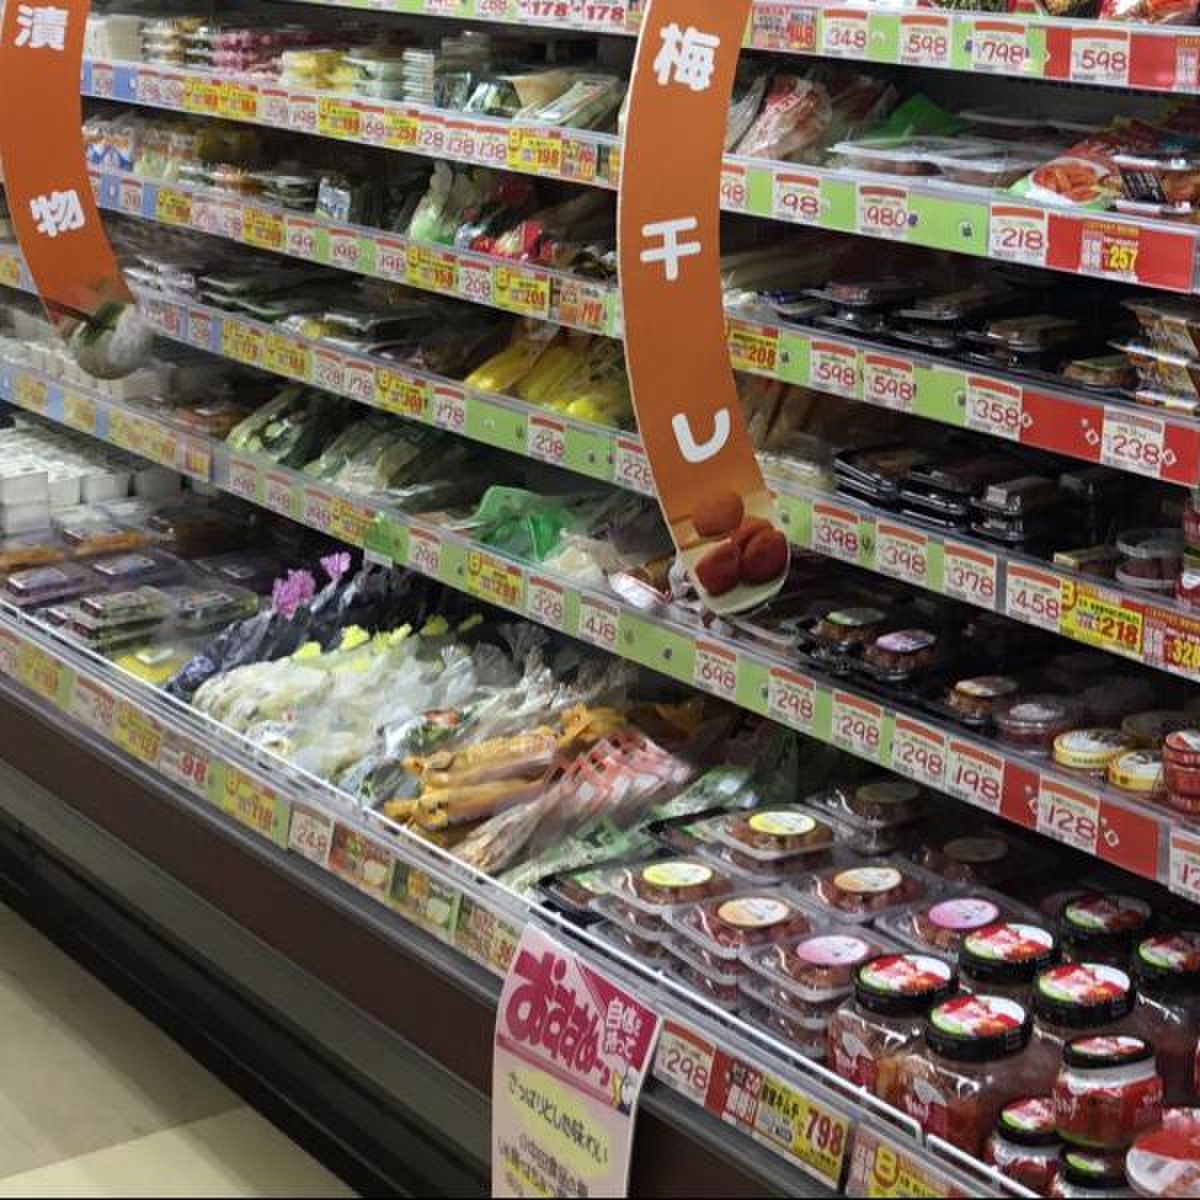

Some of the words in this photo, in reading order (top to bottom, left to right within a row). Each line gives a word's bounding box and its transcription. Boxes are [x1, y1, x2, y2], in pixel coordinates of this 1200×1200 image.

[907, 33, 949, 55] 598
[981, 40, 1025, 65] 798
[1080, 49, 1127, 71] 598
[15, 3, 86, 238] 漬物
[781, 193, 819, 215] 98
[867, 204, 907, 227] 980
[640, 22, 731, 464] 梅干し
[1000, 227, 1043, 249] 218
[817, 361, 856, 386] 598
[873, 375, 913, 400] 598
[975, 398, 1020, 427] 358
[778, 687, 815, 721] 298
[841, 717, 881, 748] 298
[903, 742, 944, 776] 298
[954, 765, 1001, 801] 198
[1049, 804, 1097, 841] 128
[667, 1050, 709, 1089] 298
[804, 1107, 844, 1158] 798
